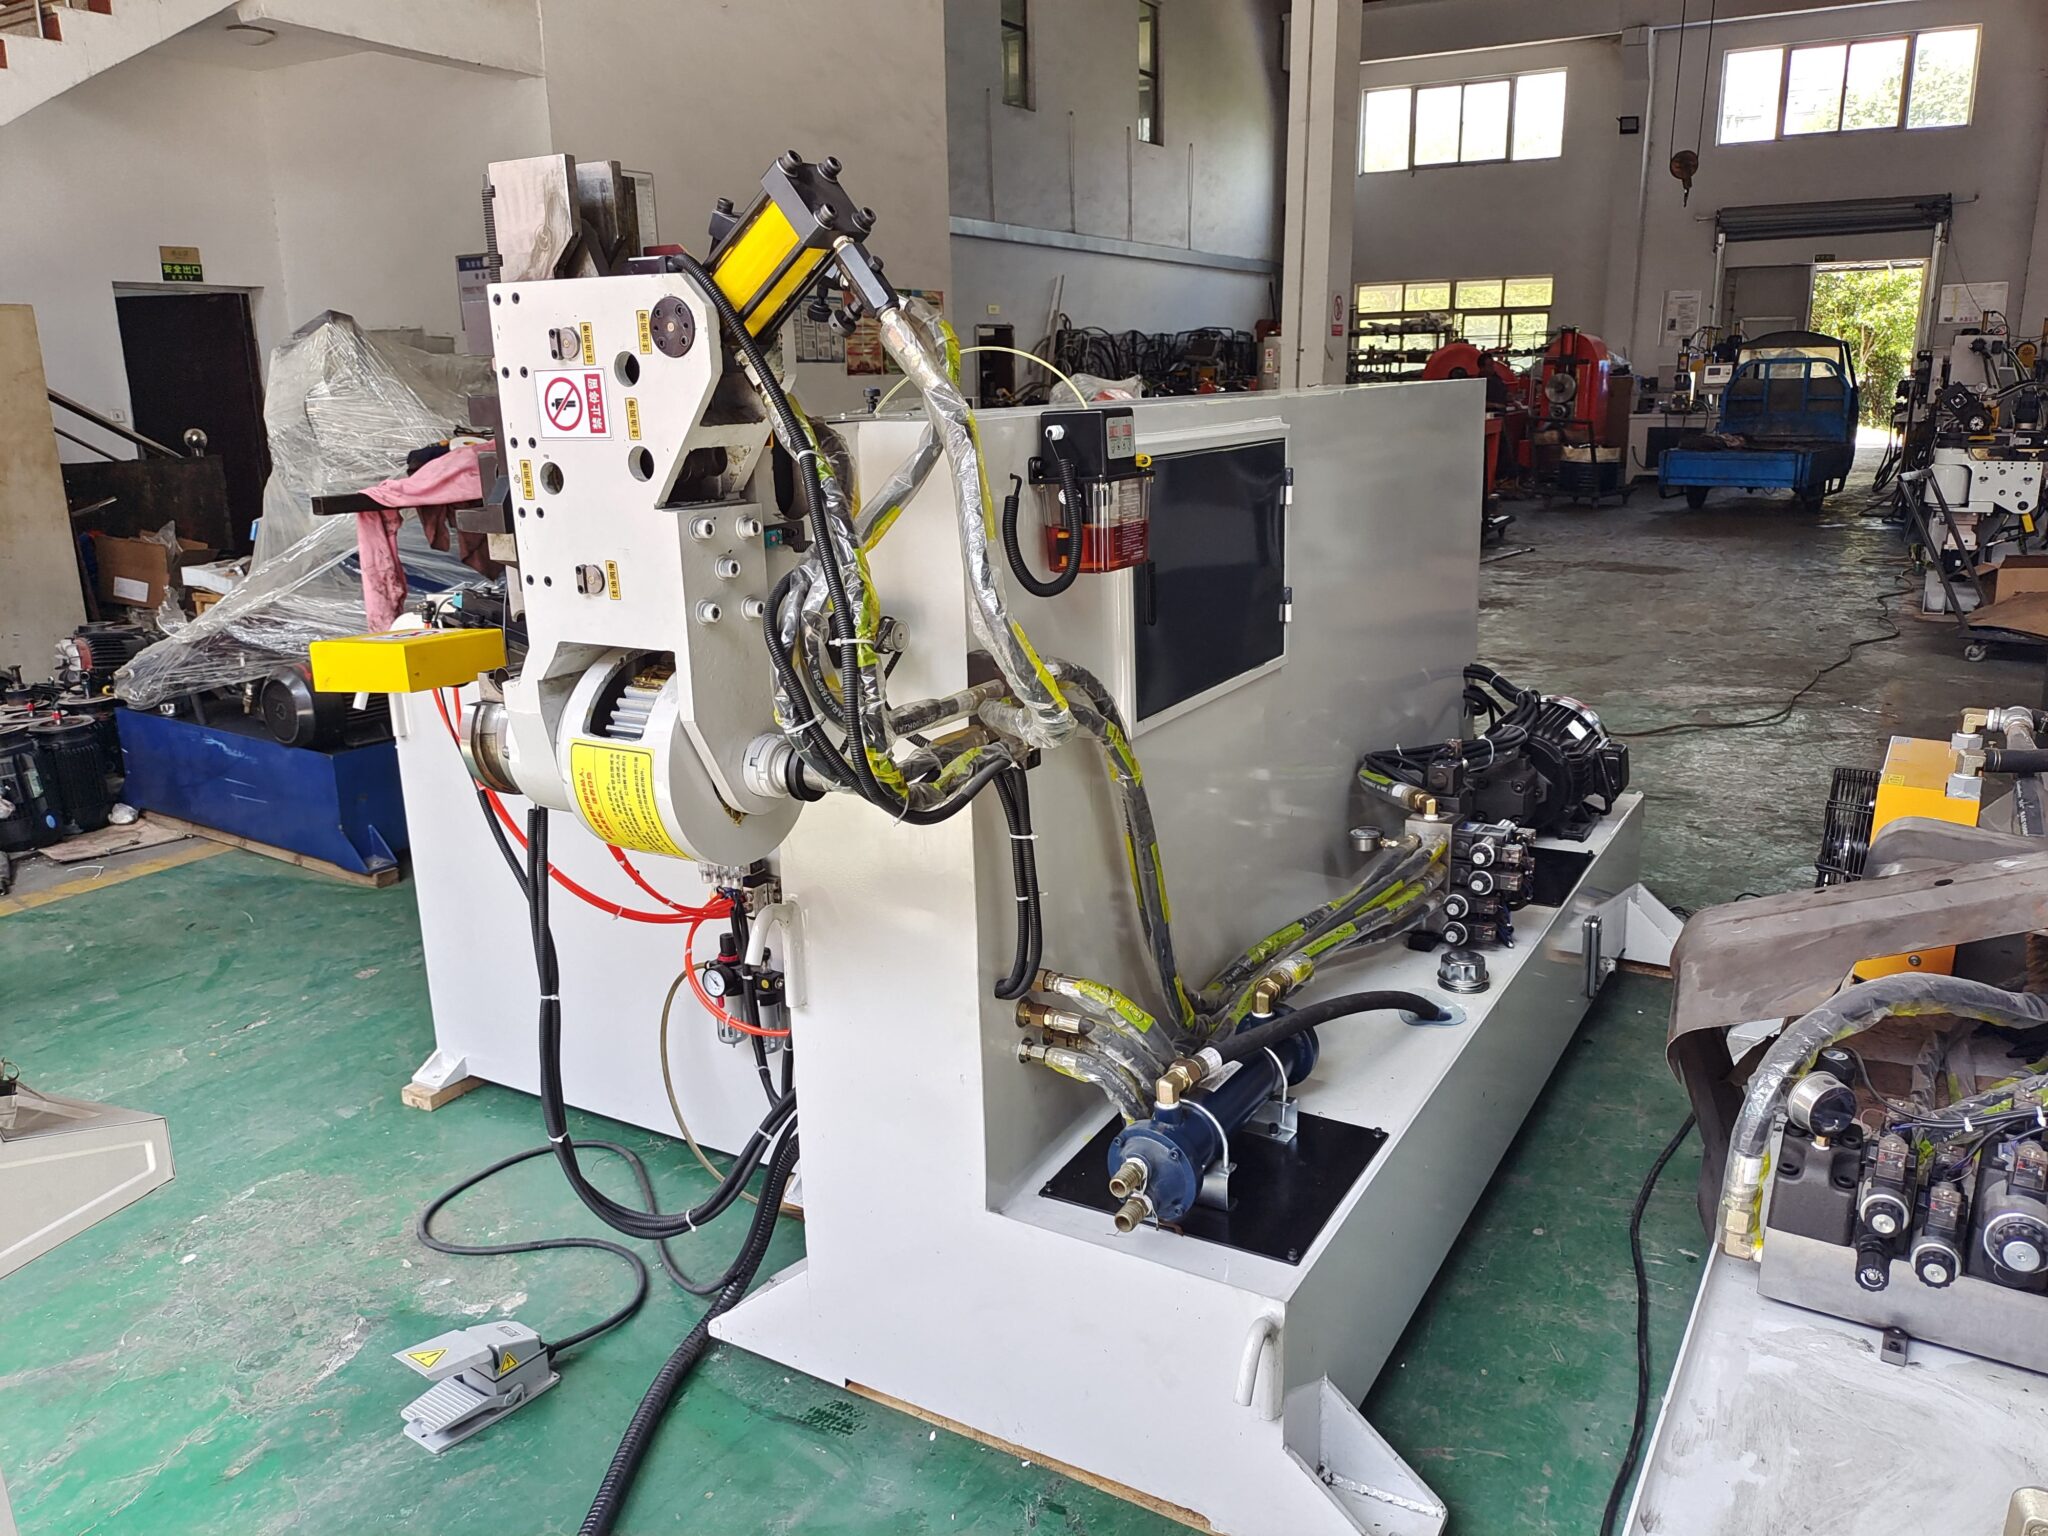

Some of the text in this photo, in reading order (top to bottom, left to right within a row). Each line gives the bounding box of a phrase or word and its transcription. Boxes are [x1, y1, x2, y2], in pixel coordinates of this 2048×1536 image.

[163, 265, 201, 275] 安全出口
[582, 324, 594, 363] 注油润滑
[587, 378, 603, 430] 禁止停留
